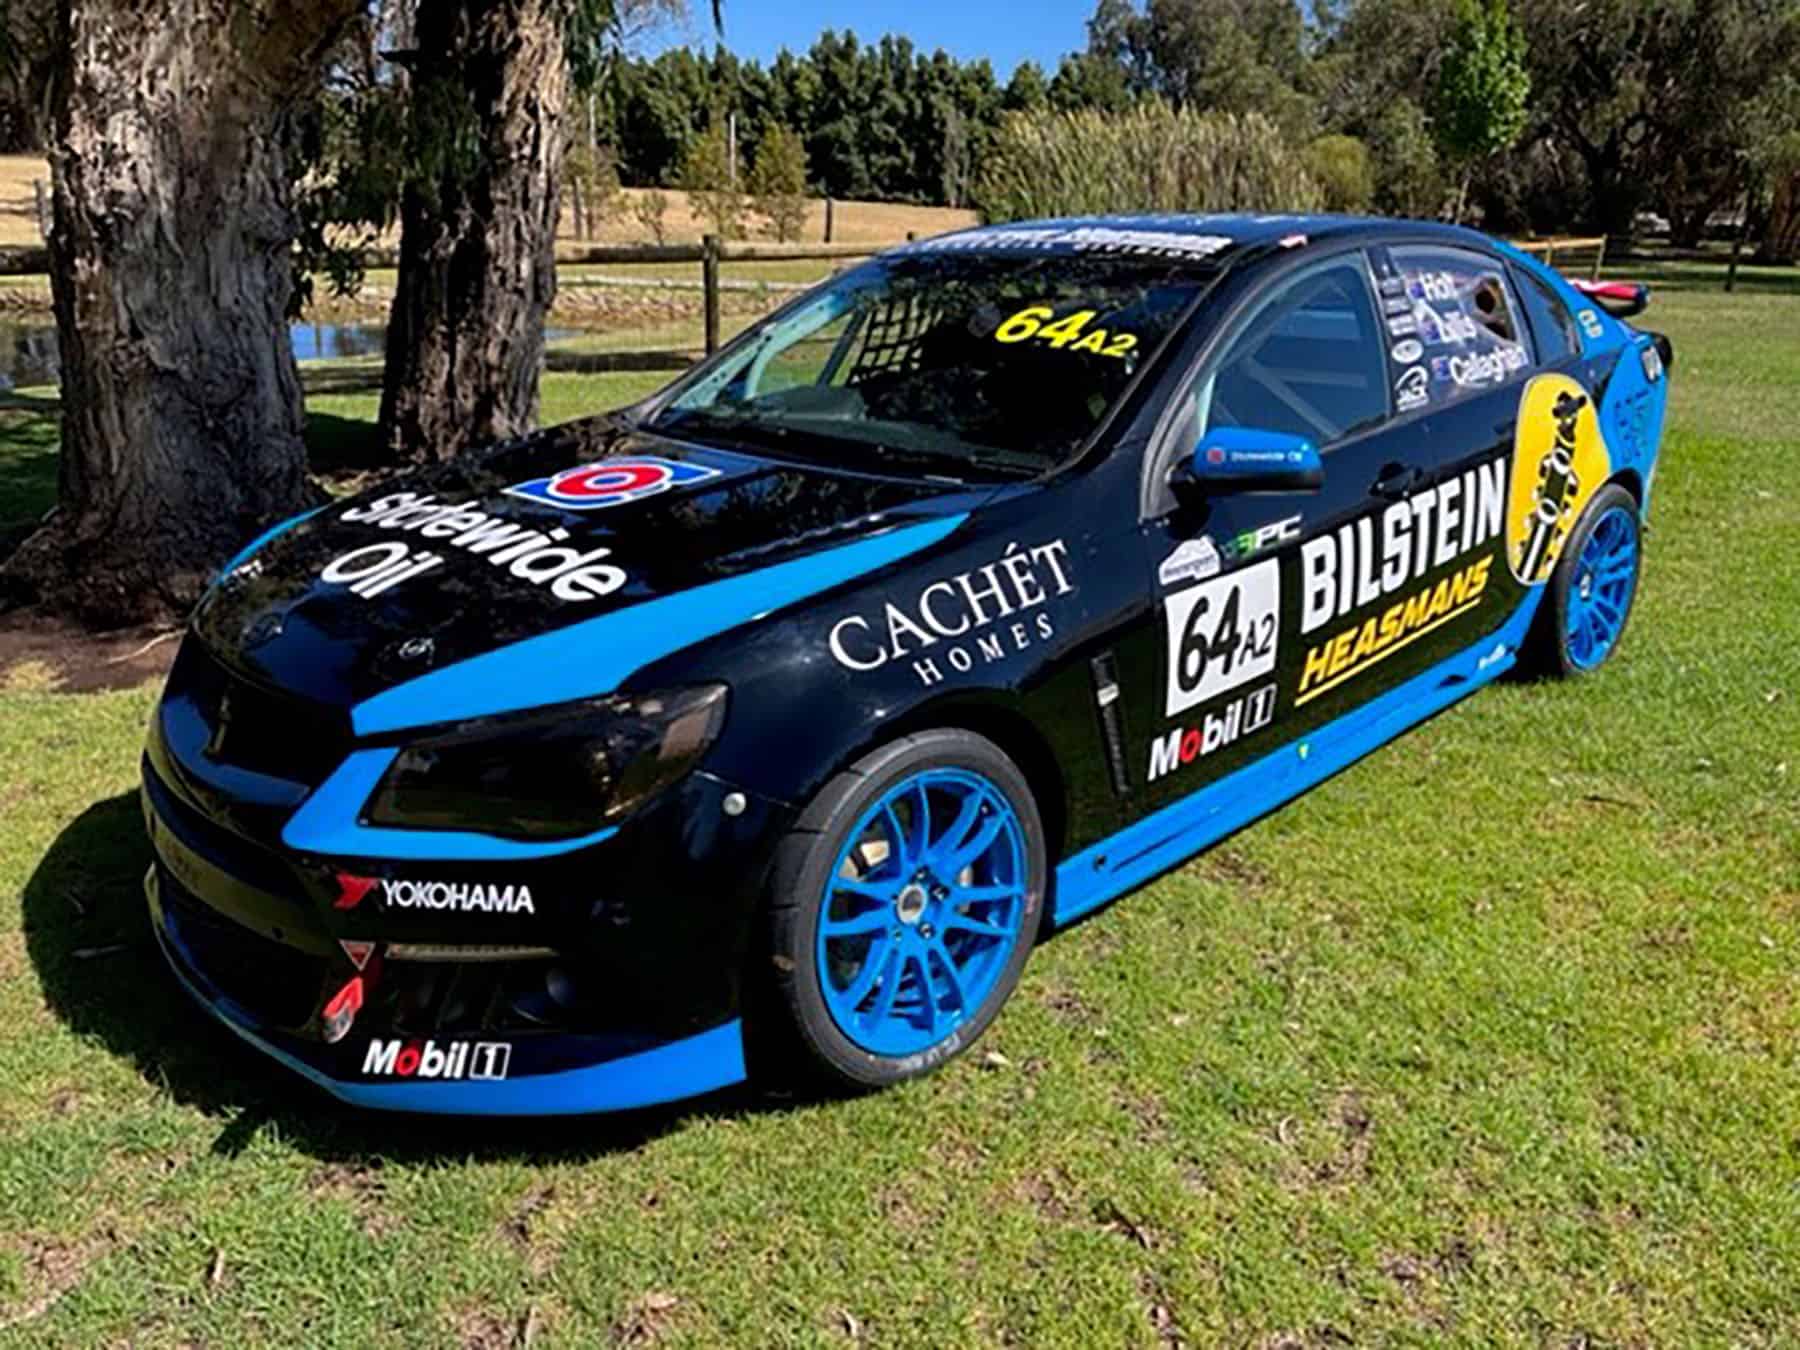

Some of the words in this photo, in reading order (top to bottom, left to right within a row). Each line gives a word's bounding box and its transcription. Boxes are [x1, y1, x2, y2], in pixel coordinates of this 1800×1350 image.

[321, 541, 444, 600] Oil
[340, 492, 627, 600] Statewide
[1301, 457, 1505, 635] BILSTEIN
[829, 539, 1074, 670] CACHÉT
[1299, 555, 1493, 692] HEASMANS
[913, 612, 1054, 685] HOMES
[1147, 699, 1241, 782] Mobil
[382, 879, 535, 914] YOKOHAMA
[362, 1039, 468, 1079] Mobil
